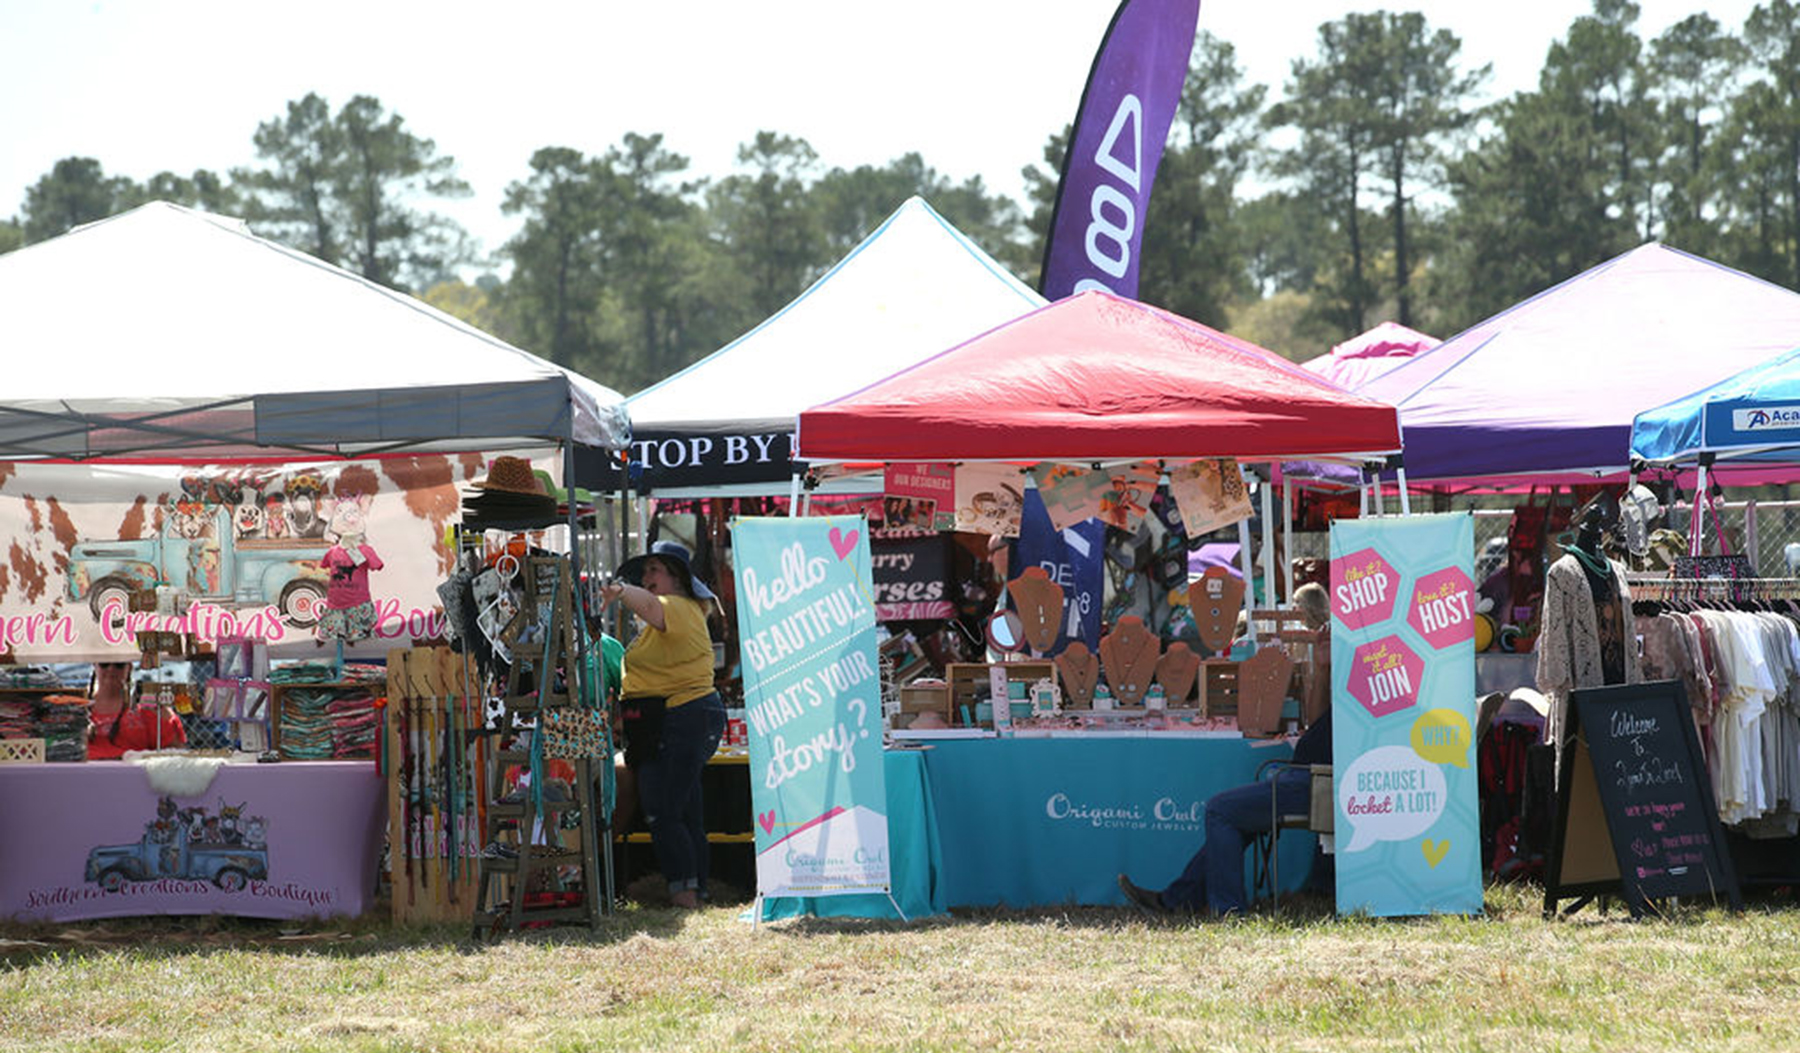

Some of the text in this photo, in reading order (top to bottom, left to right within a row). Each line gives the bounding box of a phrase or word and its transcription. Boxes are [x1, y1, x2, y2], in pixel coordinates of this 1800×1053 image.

[723, 433, 778, 465] BY
[743, 541, 830, 617] hello
[1336, 573, 1388, 614] SHOP
[744, 583, 868, 672] BEAUTIFUL!
[1418, 590, 1471, 634] HOST
[748, 650, 875, 738] WHAT'S YOUR
[1367, 665, 1412, 706] JOIN
[765, 697, 869, 789] story?
[1421, 725, 1460, 746] WHY?
[1357, 769, 1426, 792] BECAUSE I
[1046, 793, 1200, 827] Origami Owl
[1347, 791, 1438, 815] locket A LOT!
[1104, 820, 1147, 829] CUSTOM
[26, 886, 107, 909] Southern
[119, 879, 209, 896] Creations
